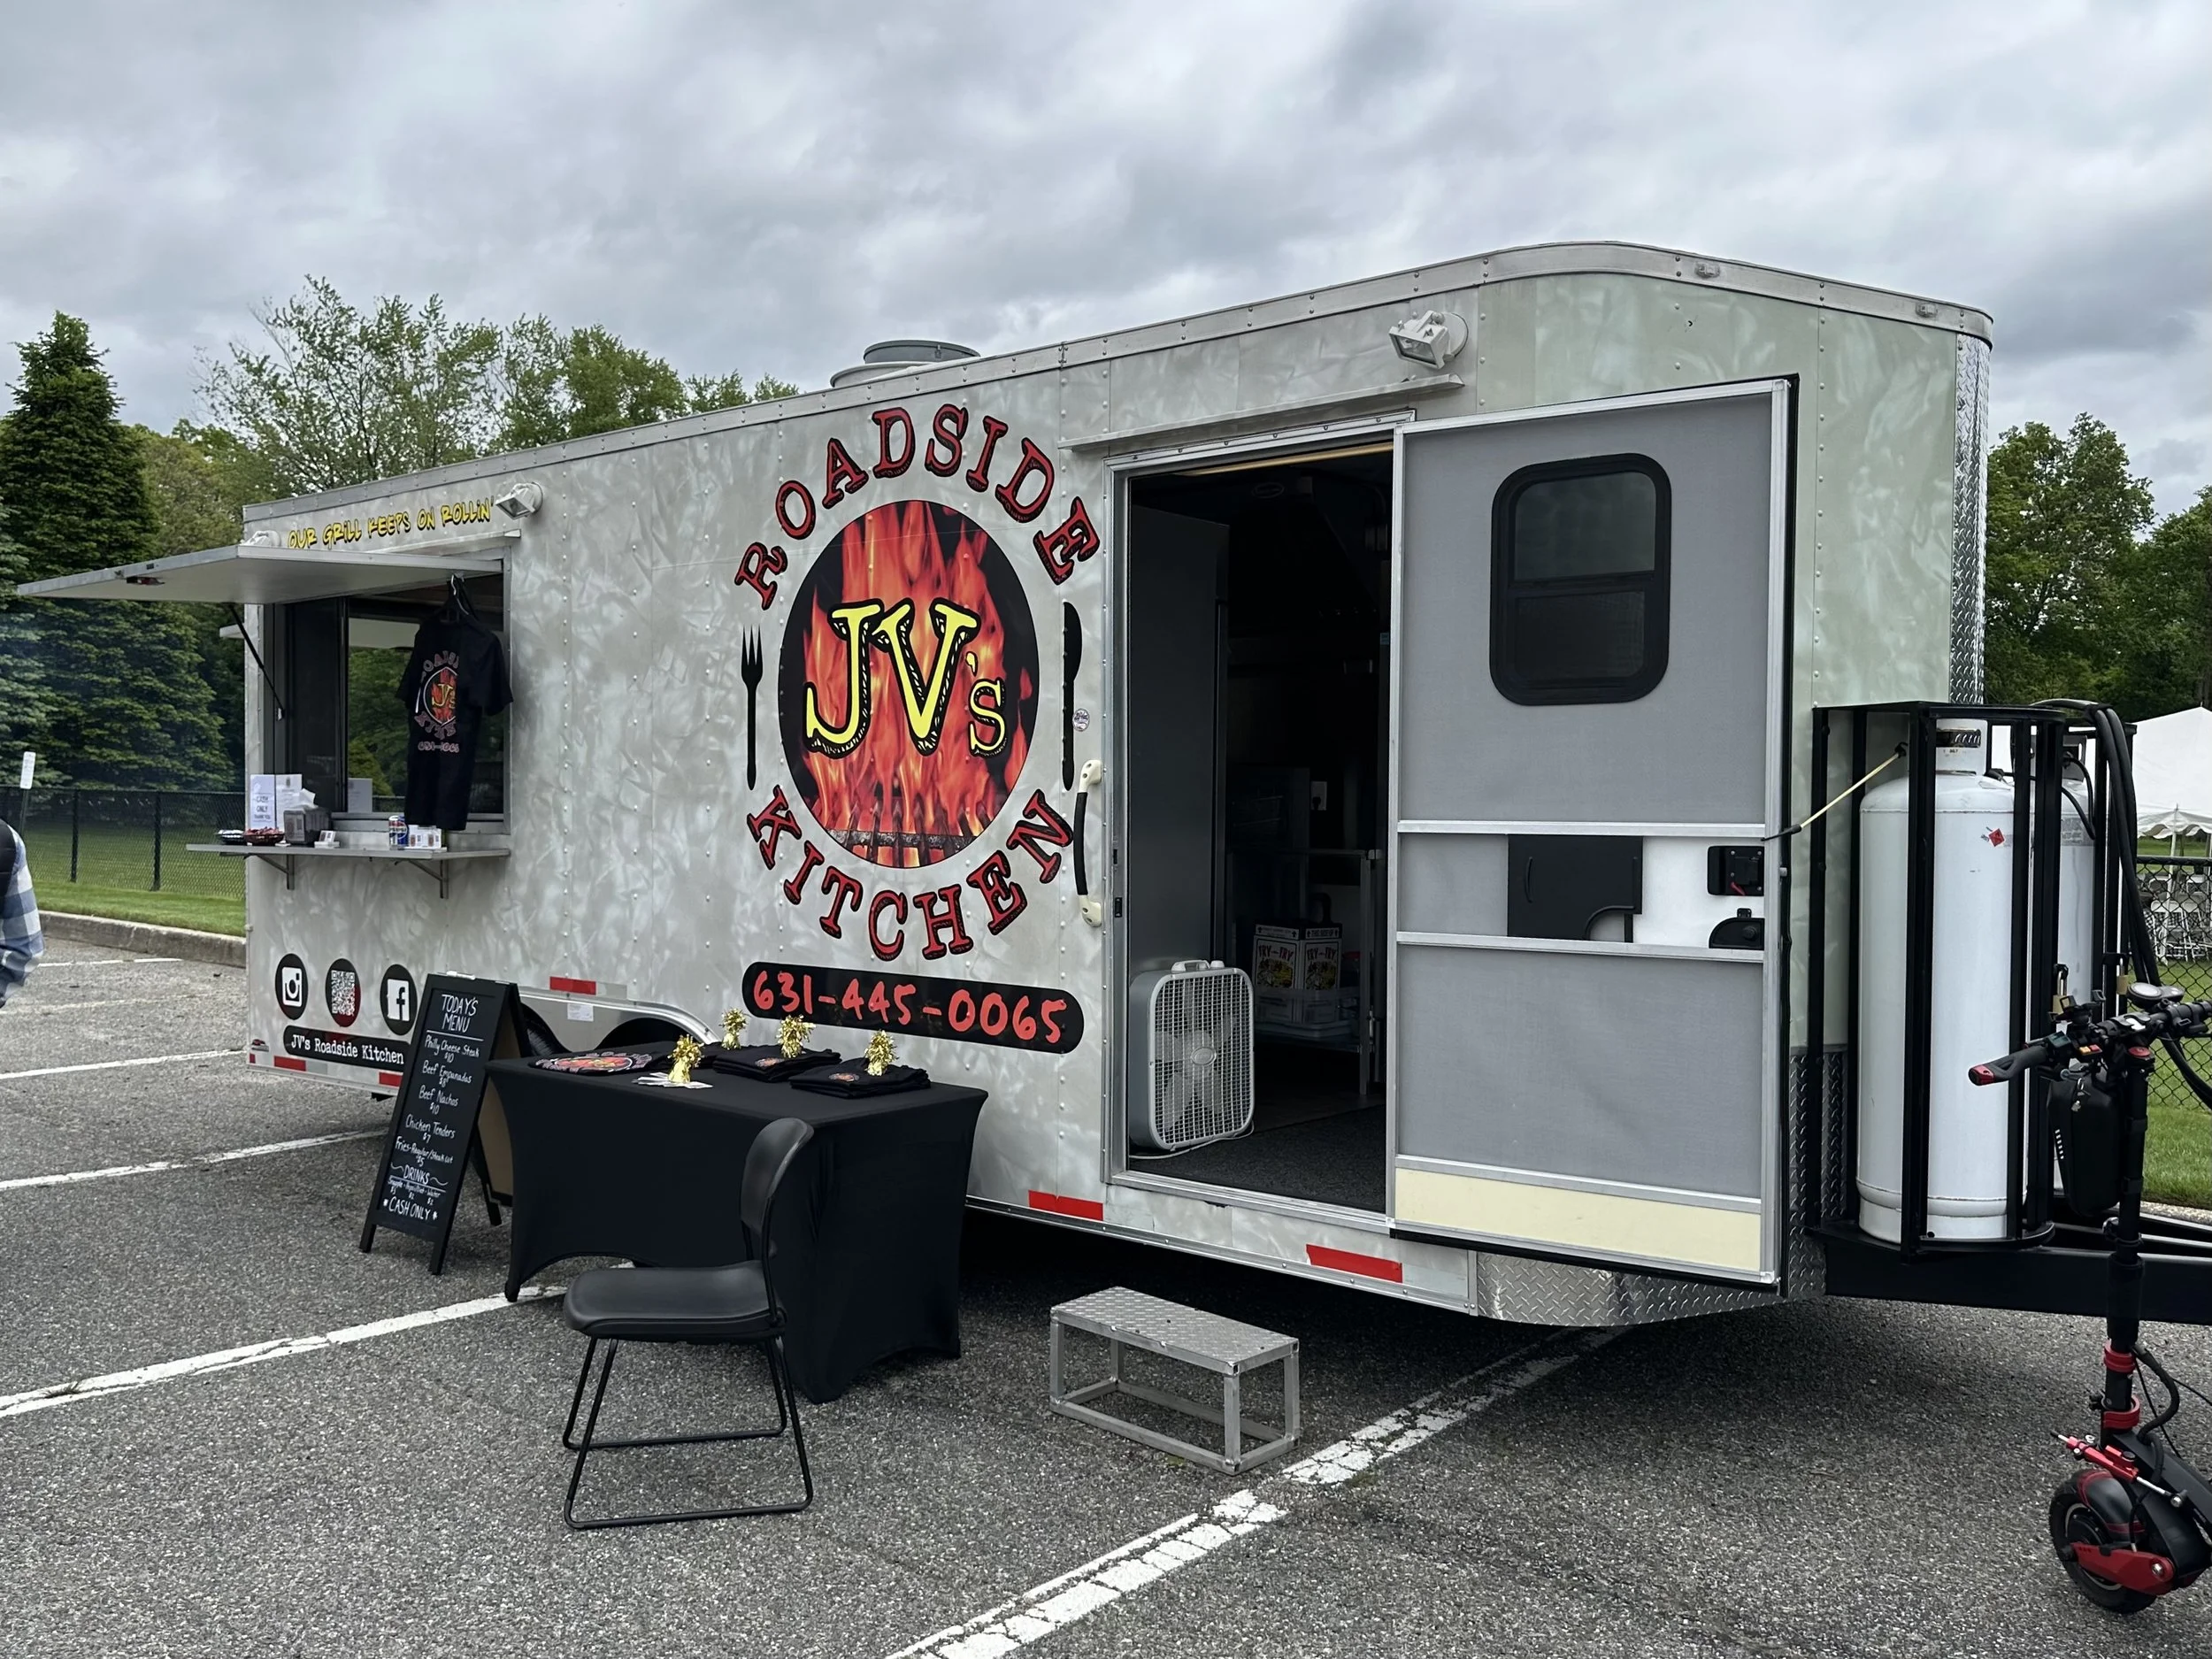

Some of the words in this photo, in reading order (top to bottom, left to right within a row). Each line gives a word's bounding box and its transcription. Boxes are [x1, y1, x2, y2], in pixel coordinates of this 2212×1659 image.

[734, 403, 1100, 611] ROADSIDE
[288, 530, 317, 549] OUR
[367, 512, 411, 539] KEEPS
[417, 506, 435, 531] ON
[803, 597, 1008, 759] JV's
[747, 785, 1073, 961] KITCHEN
[442, 994, 478, 1017] TODAY'S
[753, 970, 1067, 1045] 631-445-0065
[442, 1012, 471, 1033] MENU
[291, 1034, 311, 1050] JV's
[315, 1038, 358, 1058] Roadside
[362, 1045, 404, 1064] Kitchen
[425, 1034, 440, 1056] Philly
[441, 1040, 461, 1054] Cheese
[462, 1044, 480, 1057] Steak
[444, 1052, 455, 1063] $10
[422, 1059, 439, 1074] Beef
[439, 1065, 472, 1084] Empanadas
[419, 1085, 436, 1100] Beef
[436, 1090, 458, 1107] Nachos
[430, 1102, 440, 1115] $10
[405, 1113, 431, 1132] Chicken
[433, 1121, 456, 1139] Tenders
[423, 1133, 431, 1144] $7
[403, 1164, 430, 1185] DRINKS
[389, 1196, 410, 1216] CASH
[410, 1203, 431, 1220] ONLY
